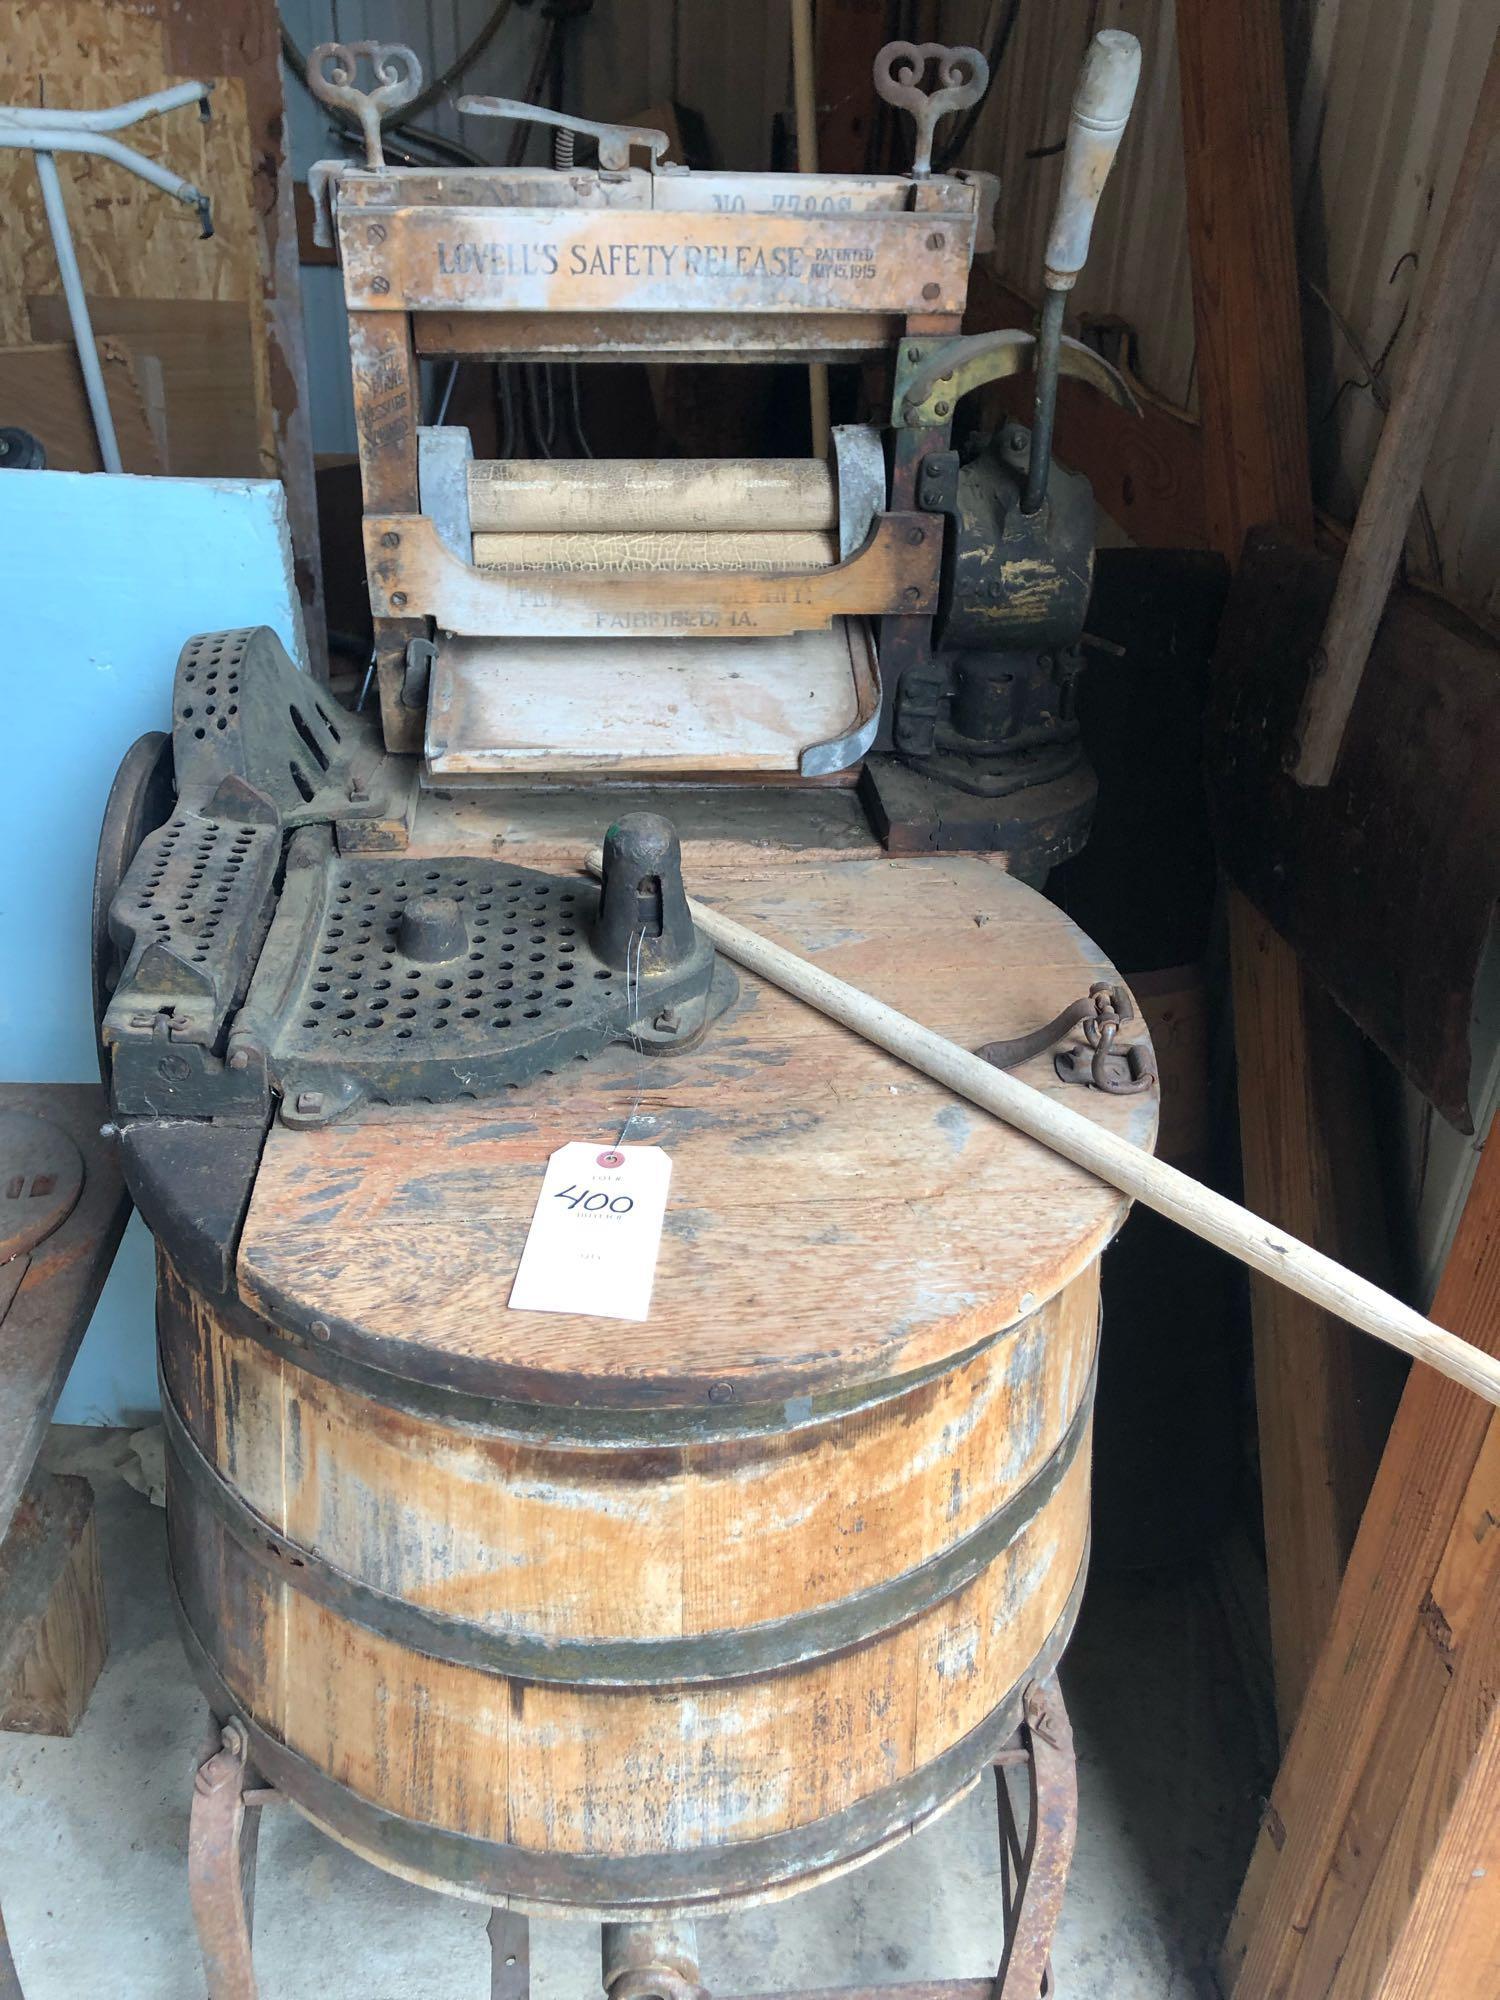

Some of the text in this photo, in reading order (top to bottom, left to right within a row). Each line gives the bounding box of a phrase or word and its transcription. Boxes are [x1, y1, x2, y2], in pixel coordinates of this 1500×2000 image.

[437, 242, 804, 278] LOVELL'S SAFETY RELEASE
[554, 1184, 634, 1214] 400
